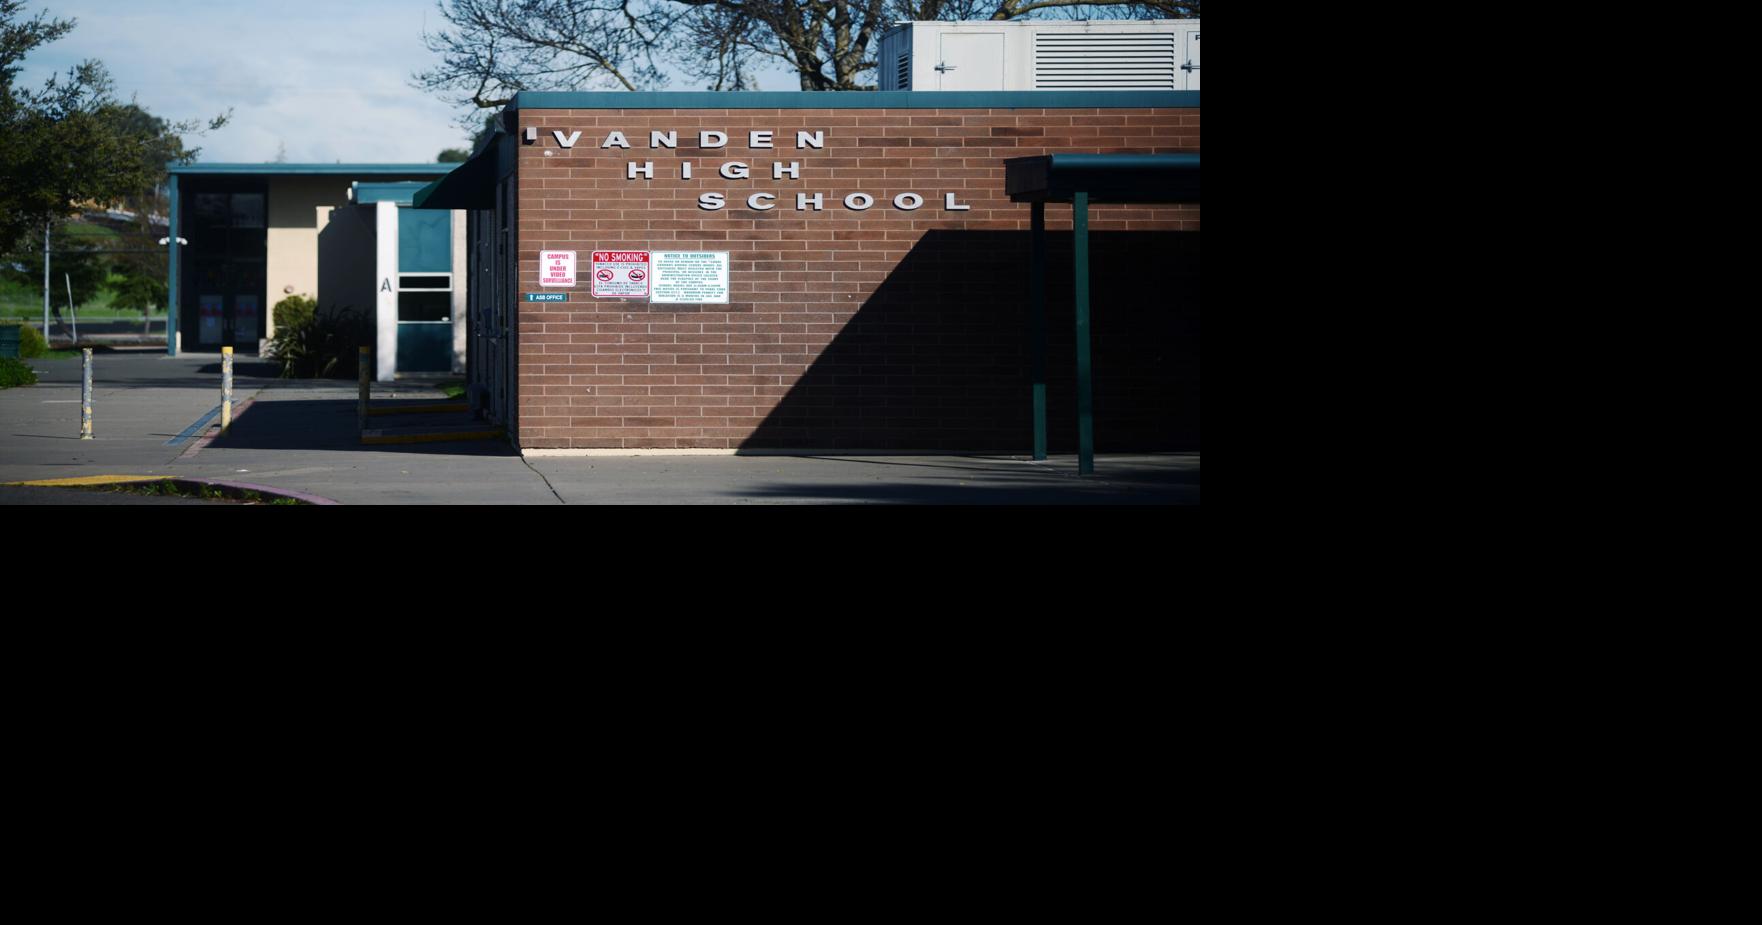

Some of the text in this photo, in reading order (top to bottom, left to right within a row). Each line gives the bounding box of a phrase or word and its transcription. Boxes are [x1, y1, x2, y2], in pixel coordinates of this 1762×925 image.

[553, 130, 824, 149] VANDEN
[627, 162, 800, 180] HIGH
[699, 192, 970, 211] SCHOOL
[598, 253, 644, 262] NO SMOKING
[380, 277, 392, 292] A
